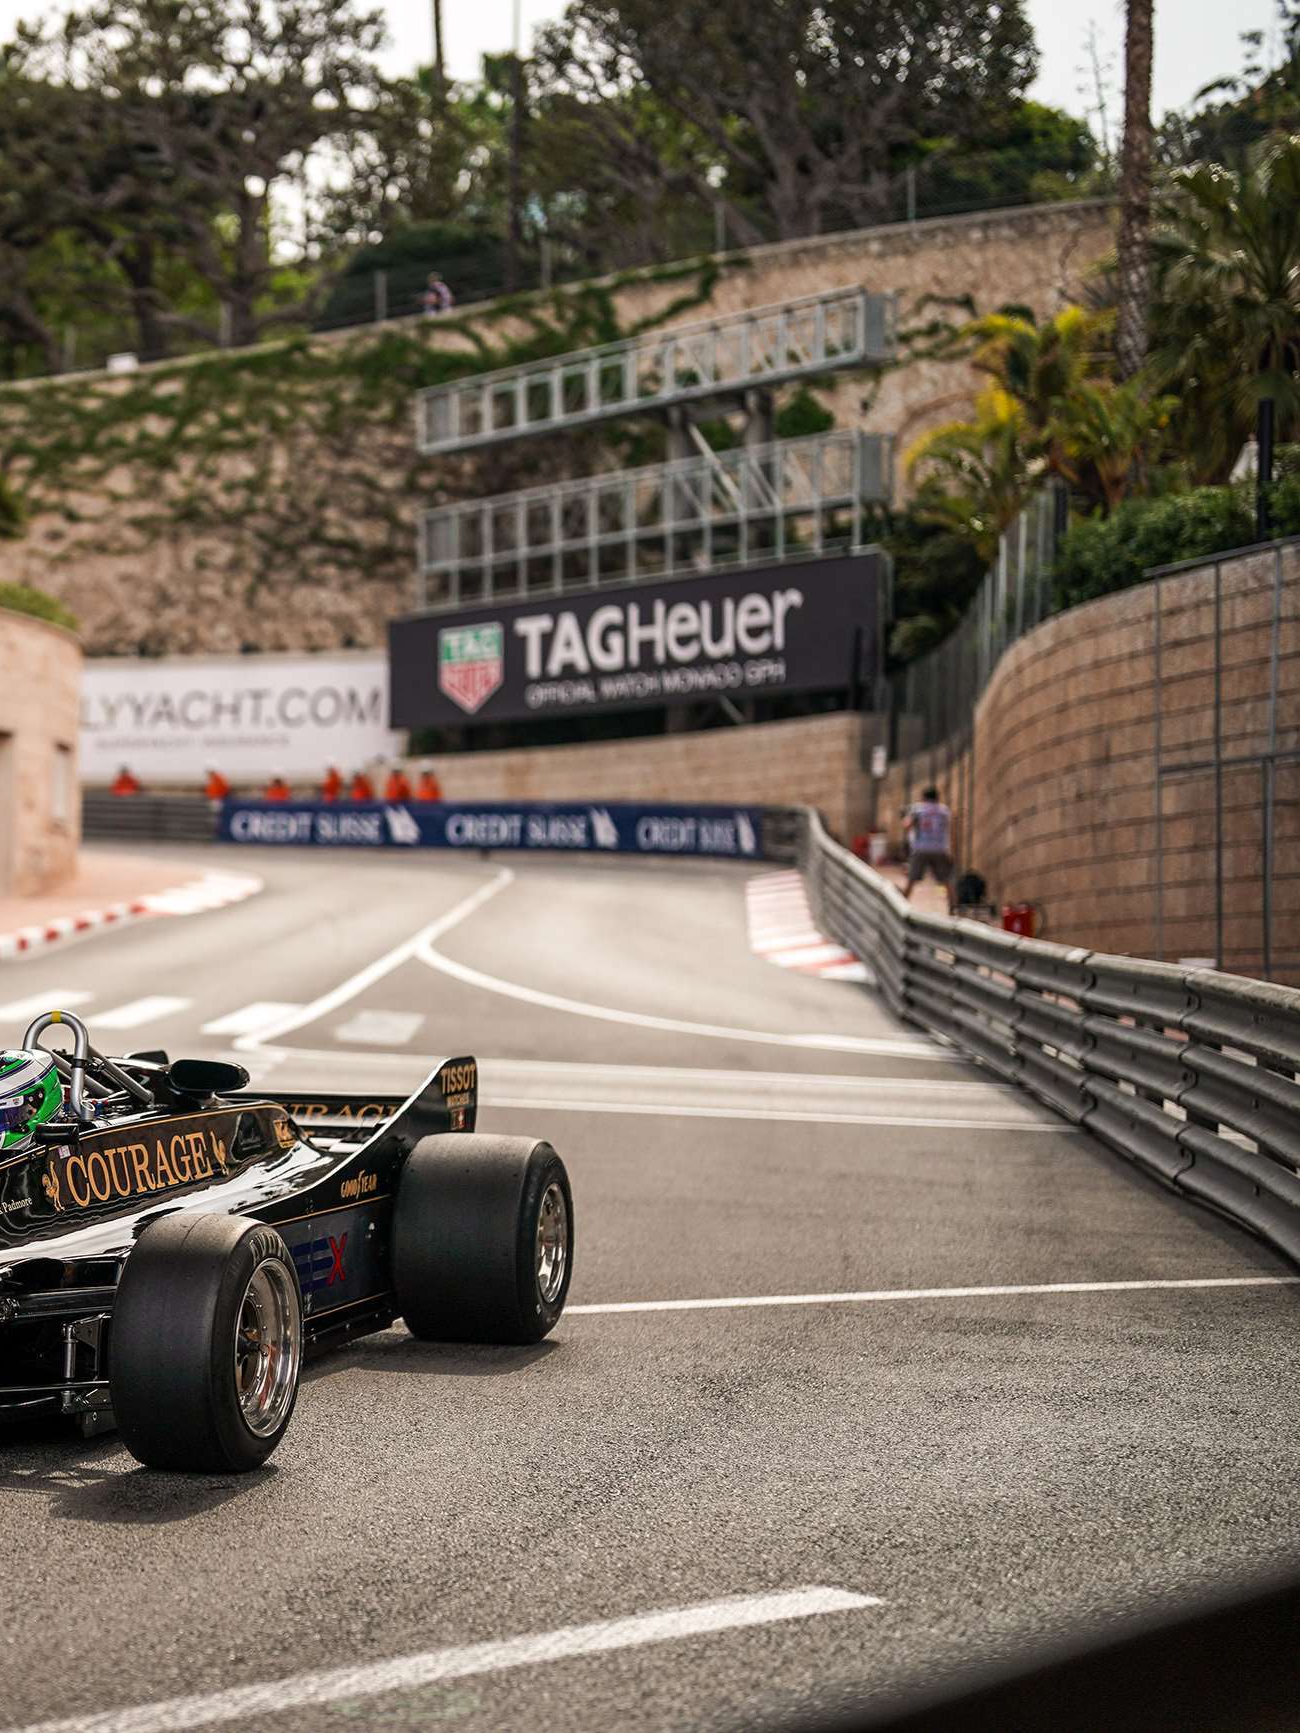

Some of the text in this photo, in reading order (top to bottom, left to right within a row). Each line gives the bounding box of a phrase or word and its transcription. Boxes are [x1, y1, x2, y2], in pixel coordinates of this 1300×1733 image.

[230, 810, 314, 843] CREDIT
[445, 813, 523, 846] CREDIT
[441, 1063, 476, 1095] TISSOT
[66, 1131, 215, 1207] COURAGE
[3, 1197, 33, 1213] Padmore
